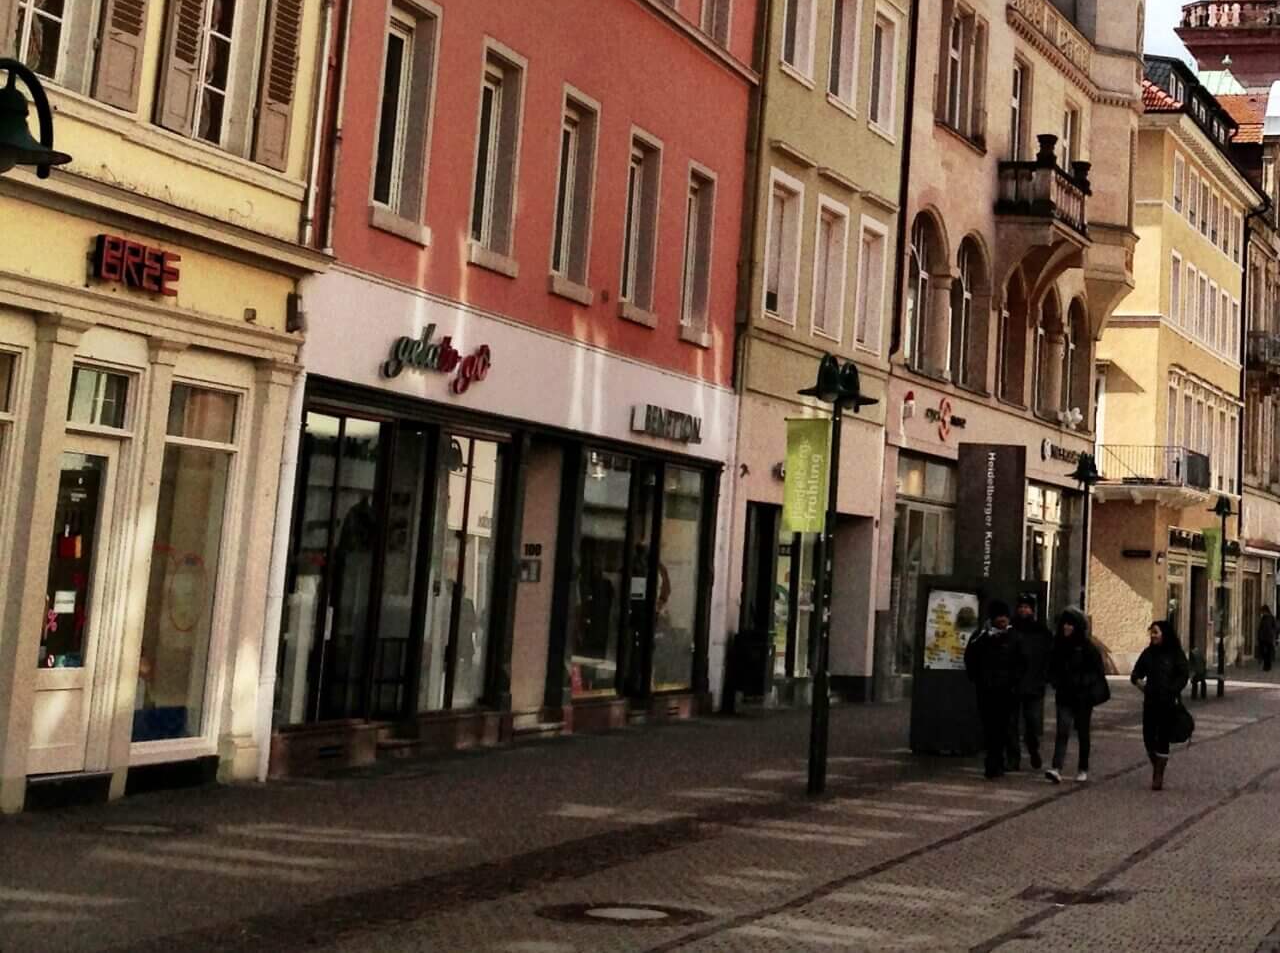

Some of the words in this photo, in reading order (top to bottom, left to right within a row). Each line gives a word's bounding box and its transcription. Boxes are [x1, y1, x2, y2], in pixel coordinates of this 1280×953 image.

[97, 234, 181, 296] BREE
[983, 452, 997, 527] Heidelberger
[524, 543, 542, 556] 100
